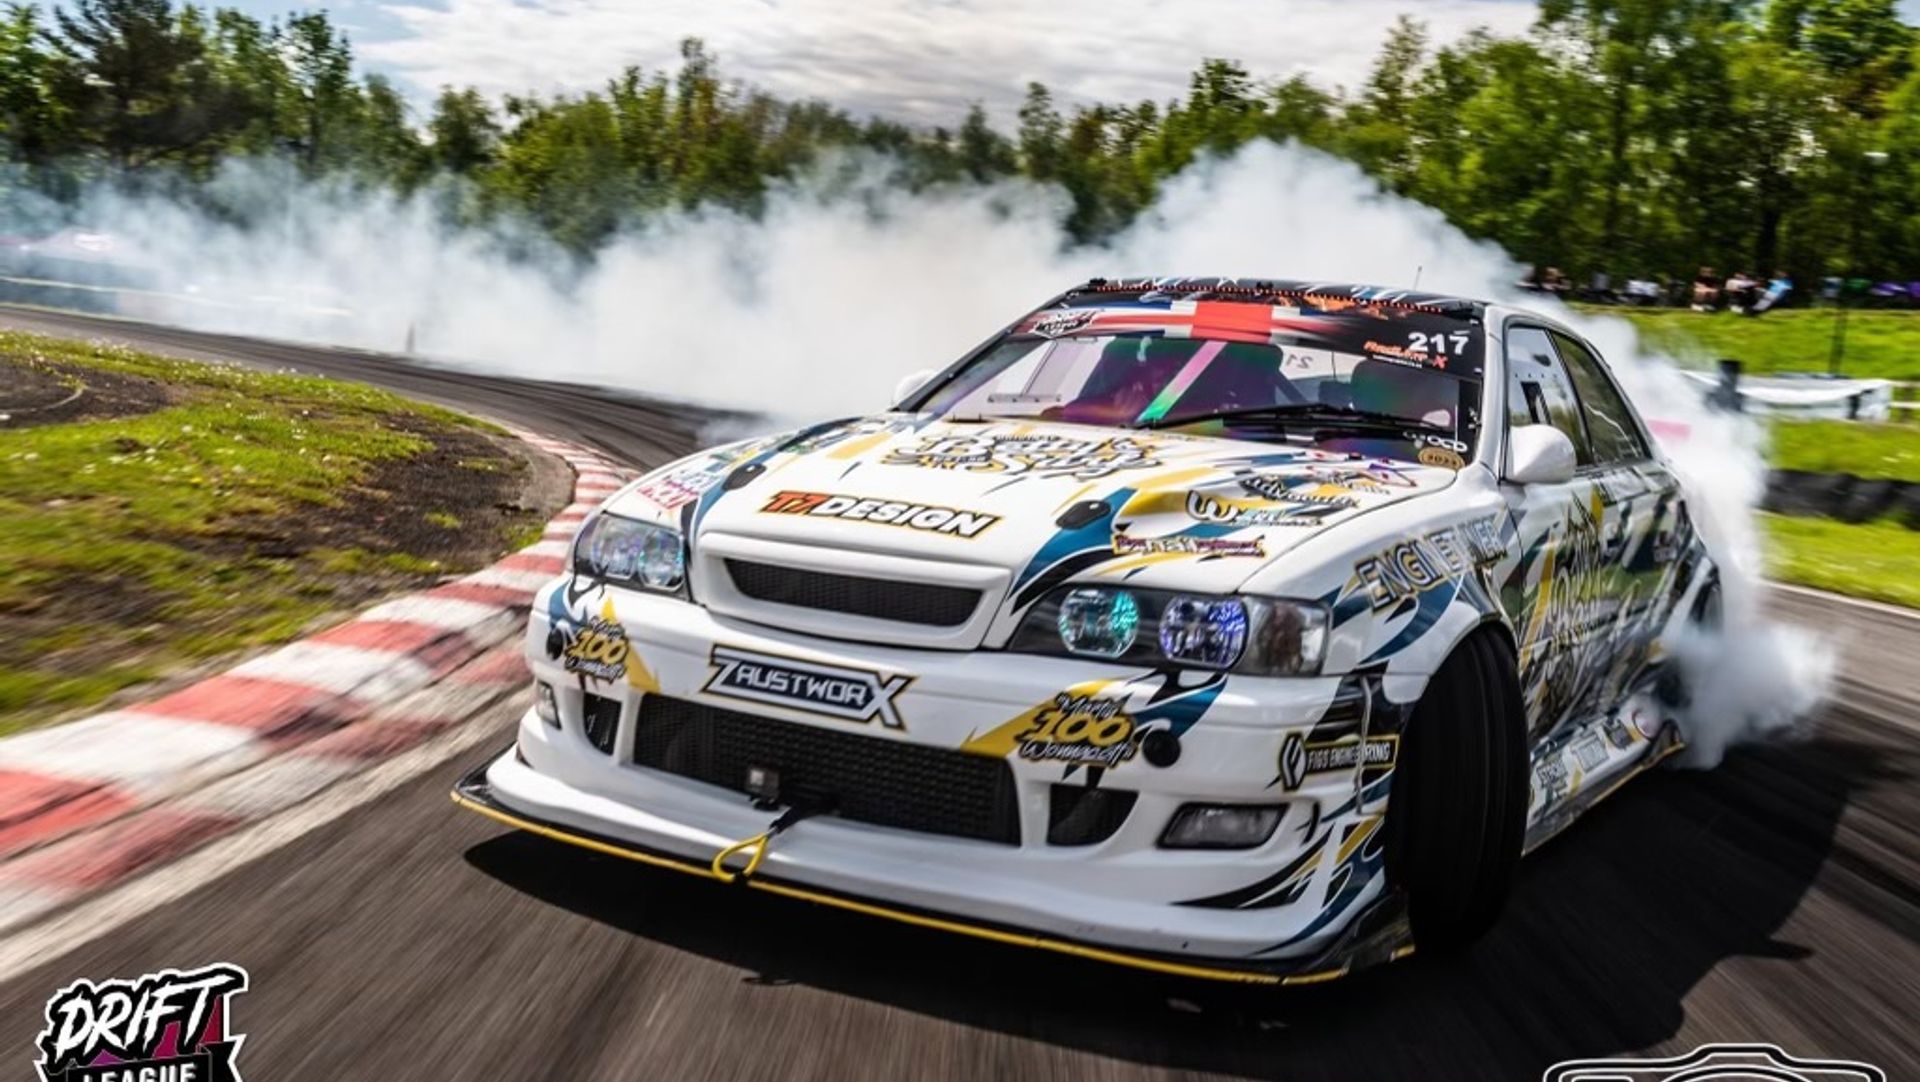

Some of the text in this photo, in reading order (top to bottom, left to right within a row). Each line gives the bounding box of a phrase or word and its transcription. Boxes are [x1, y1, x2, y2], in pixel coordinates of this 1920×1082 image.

[1408, 331, 1470, 355] 217
[566, 630, 629, 665] 100
[1016, 709, 1132, 746] 100
